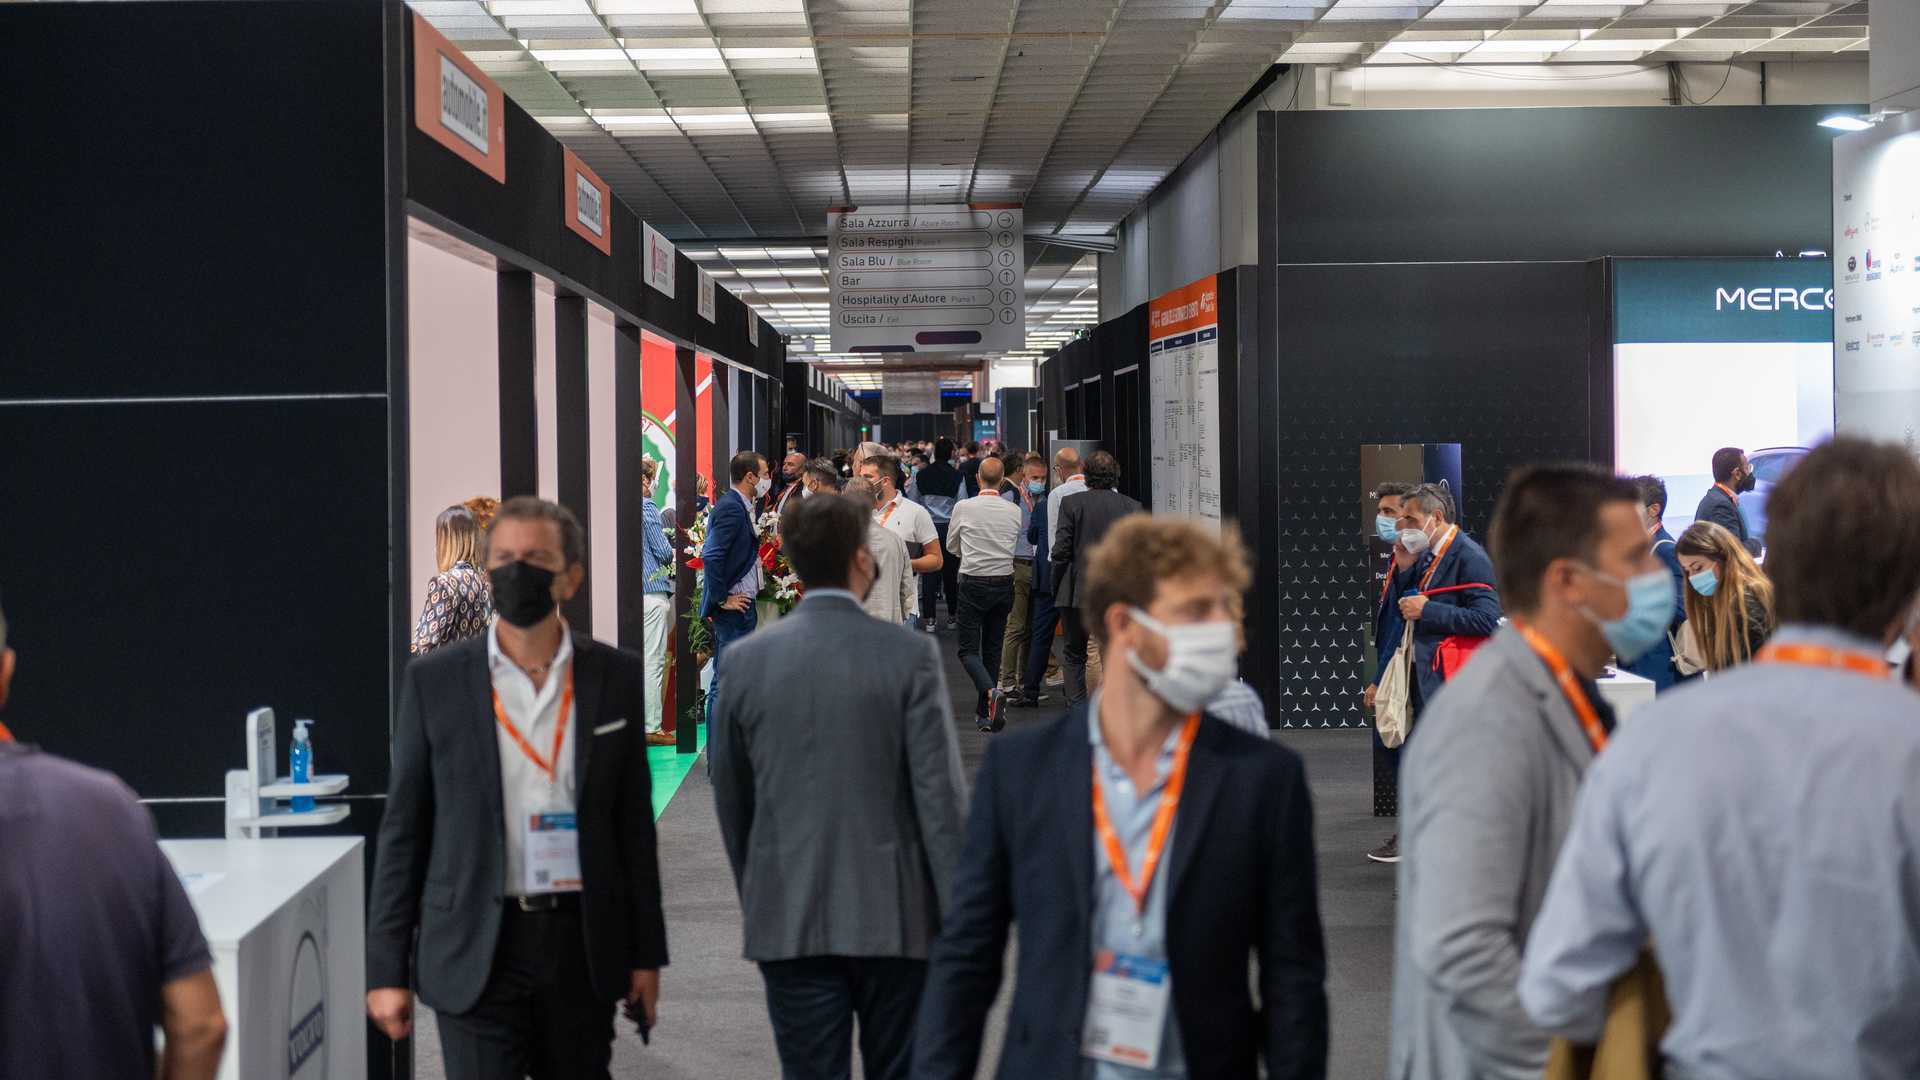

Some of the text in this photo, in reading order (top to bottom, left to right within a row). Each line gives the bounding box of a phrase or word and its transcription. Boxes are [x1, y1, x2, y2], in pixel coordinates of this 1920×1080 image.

[841, 218, 864, 229] Sala
[868, 218, 909, 228] Azzurra
[841, 238, 864, 248] Sala
[868, 236, 914, 249] Respighi
[841, 257, 865, 267] Sala
[868, 256, 886, 267] Blu
[842, 276, 861, 286] Bar
[842, 295, 899, 307] Hospitality
[903, 293, 946, 304] d'Autore
[842, 314, 876, 324] Uscita
